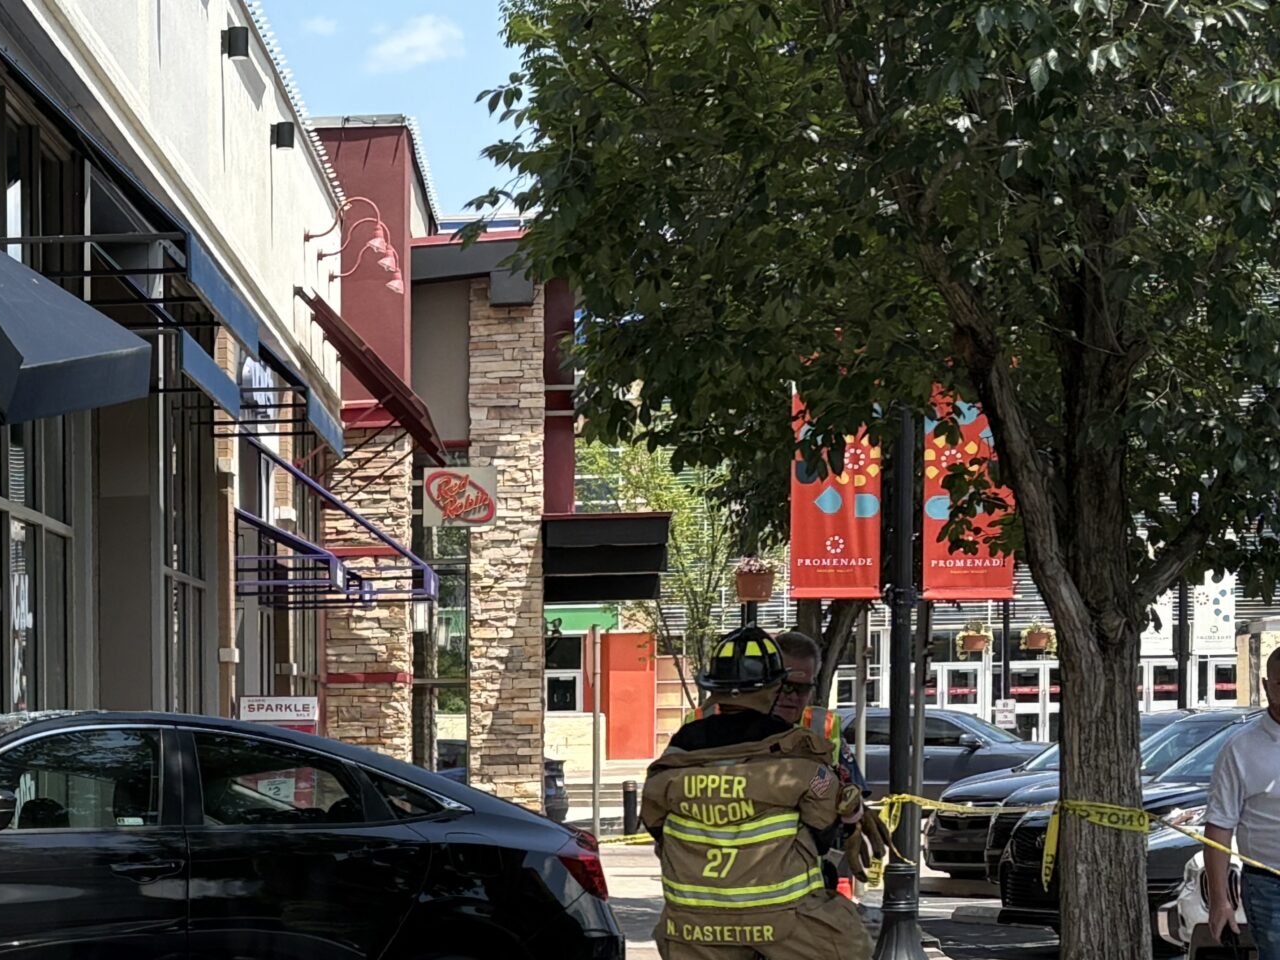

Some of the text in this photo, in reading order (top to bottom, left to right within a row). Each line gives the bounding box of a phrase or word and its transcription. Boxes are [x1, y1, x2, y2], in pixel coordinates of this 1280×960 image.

[436, 474, 470, 500] Red
[442, 491, 489, 520] Robin
[797, 558, 873, 567] PROMENADE
[248, 703, 311, 713] SPARKLE
[684, 774, 747, 799] UPPER
[680, 800, 755, 826] SAUCON
[702, 847, 739, 878] 27
[683, 923, 775, 943] CASTETTER
